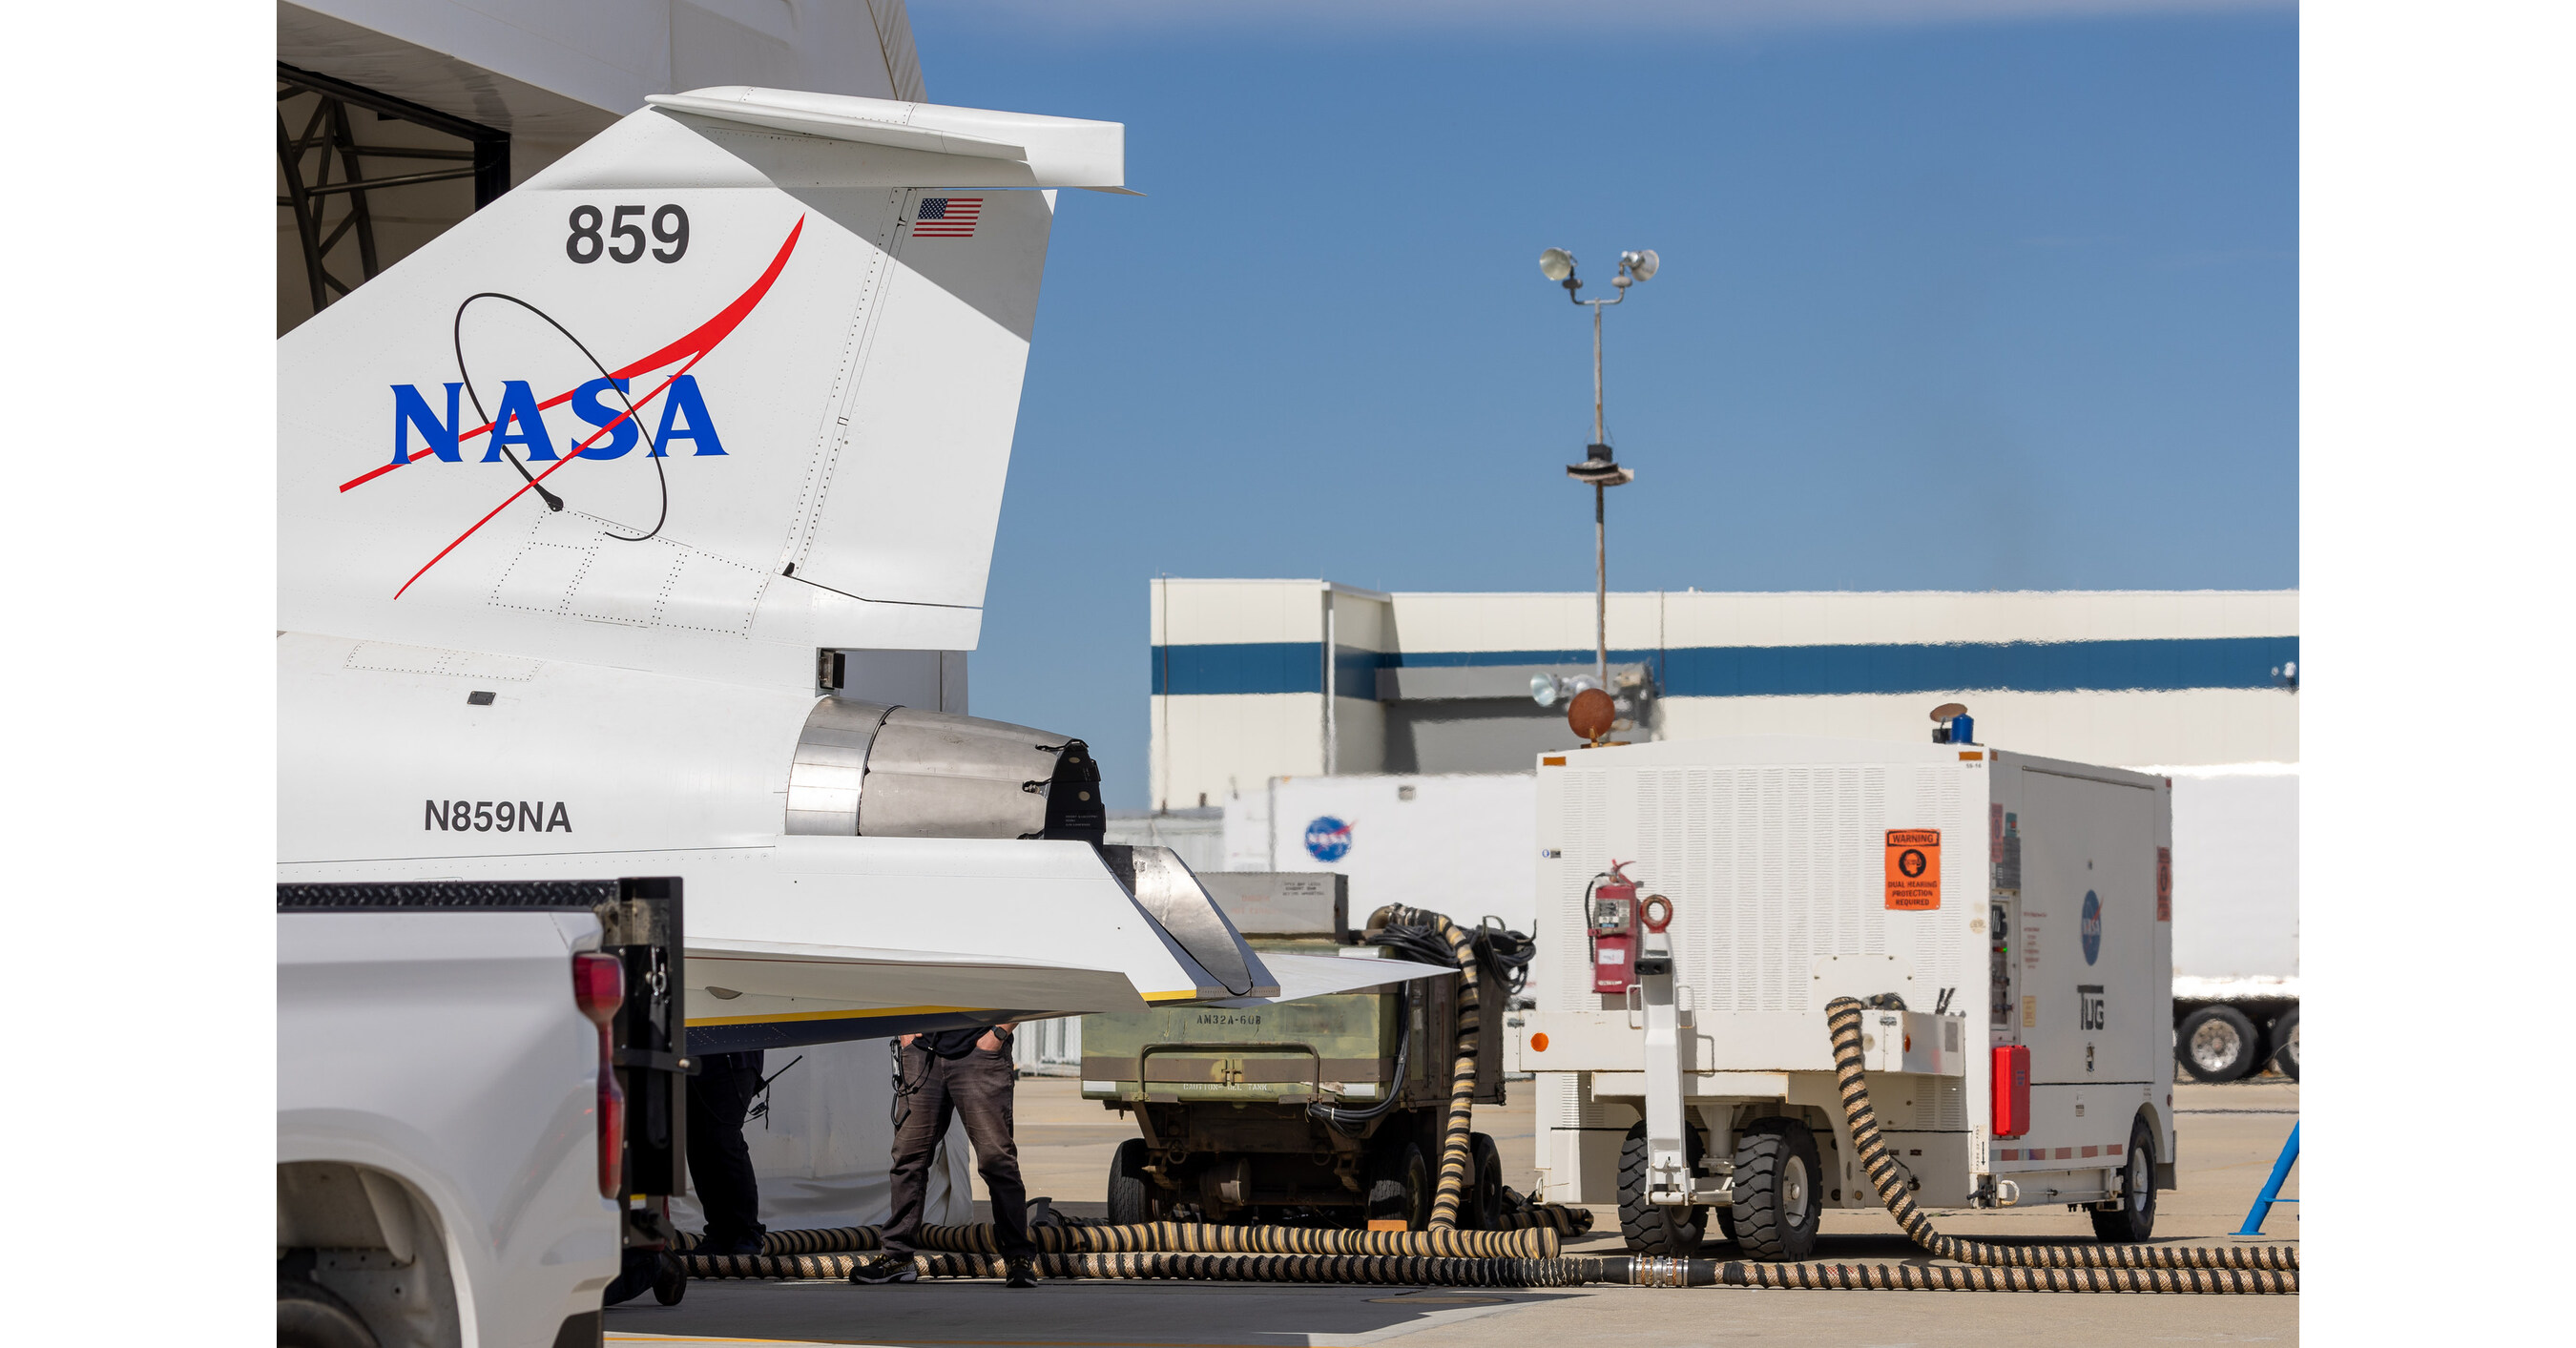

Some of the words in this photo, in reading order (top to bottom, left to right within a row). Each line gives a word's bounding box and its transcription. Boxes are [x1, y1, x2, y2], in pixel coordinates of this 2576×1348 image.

[566, 204, 690, 264] 859
[390, 375, 730, 465] NASA
[425, 799, 572, 833] N859NA
[1892, 834, 1934, 843] WARNING
[1892, 889, 1933, 898] PROTECTION
[1196, 1014, 1261, 1025] AM32A-60B
[2077, 985, 2104, 1030] TUG
